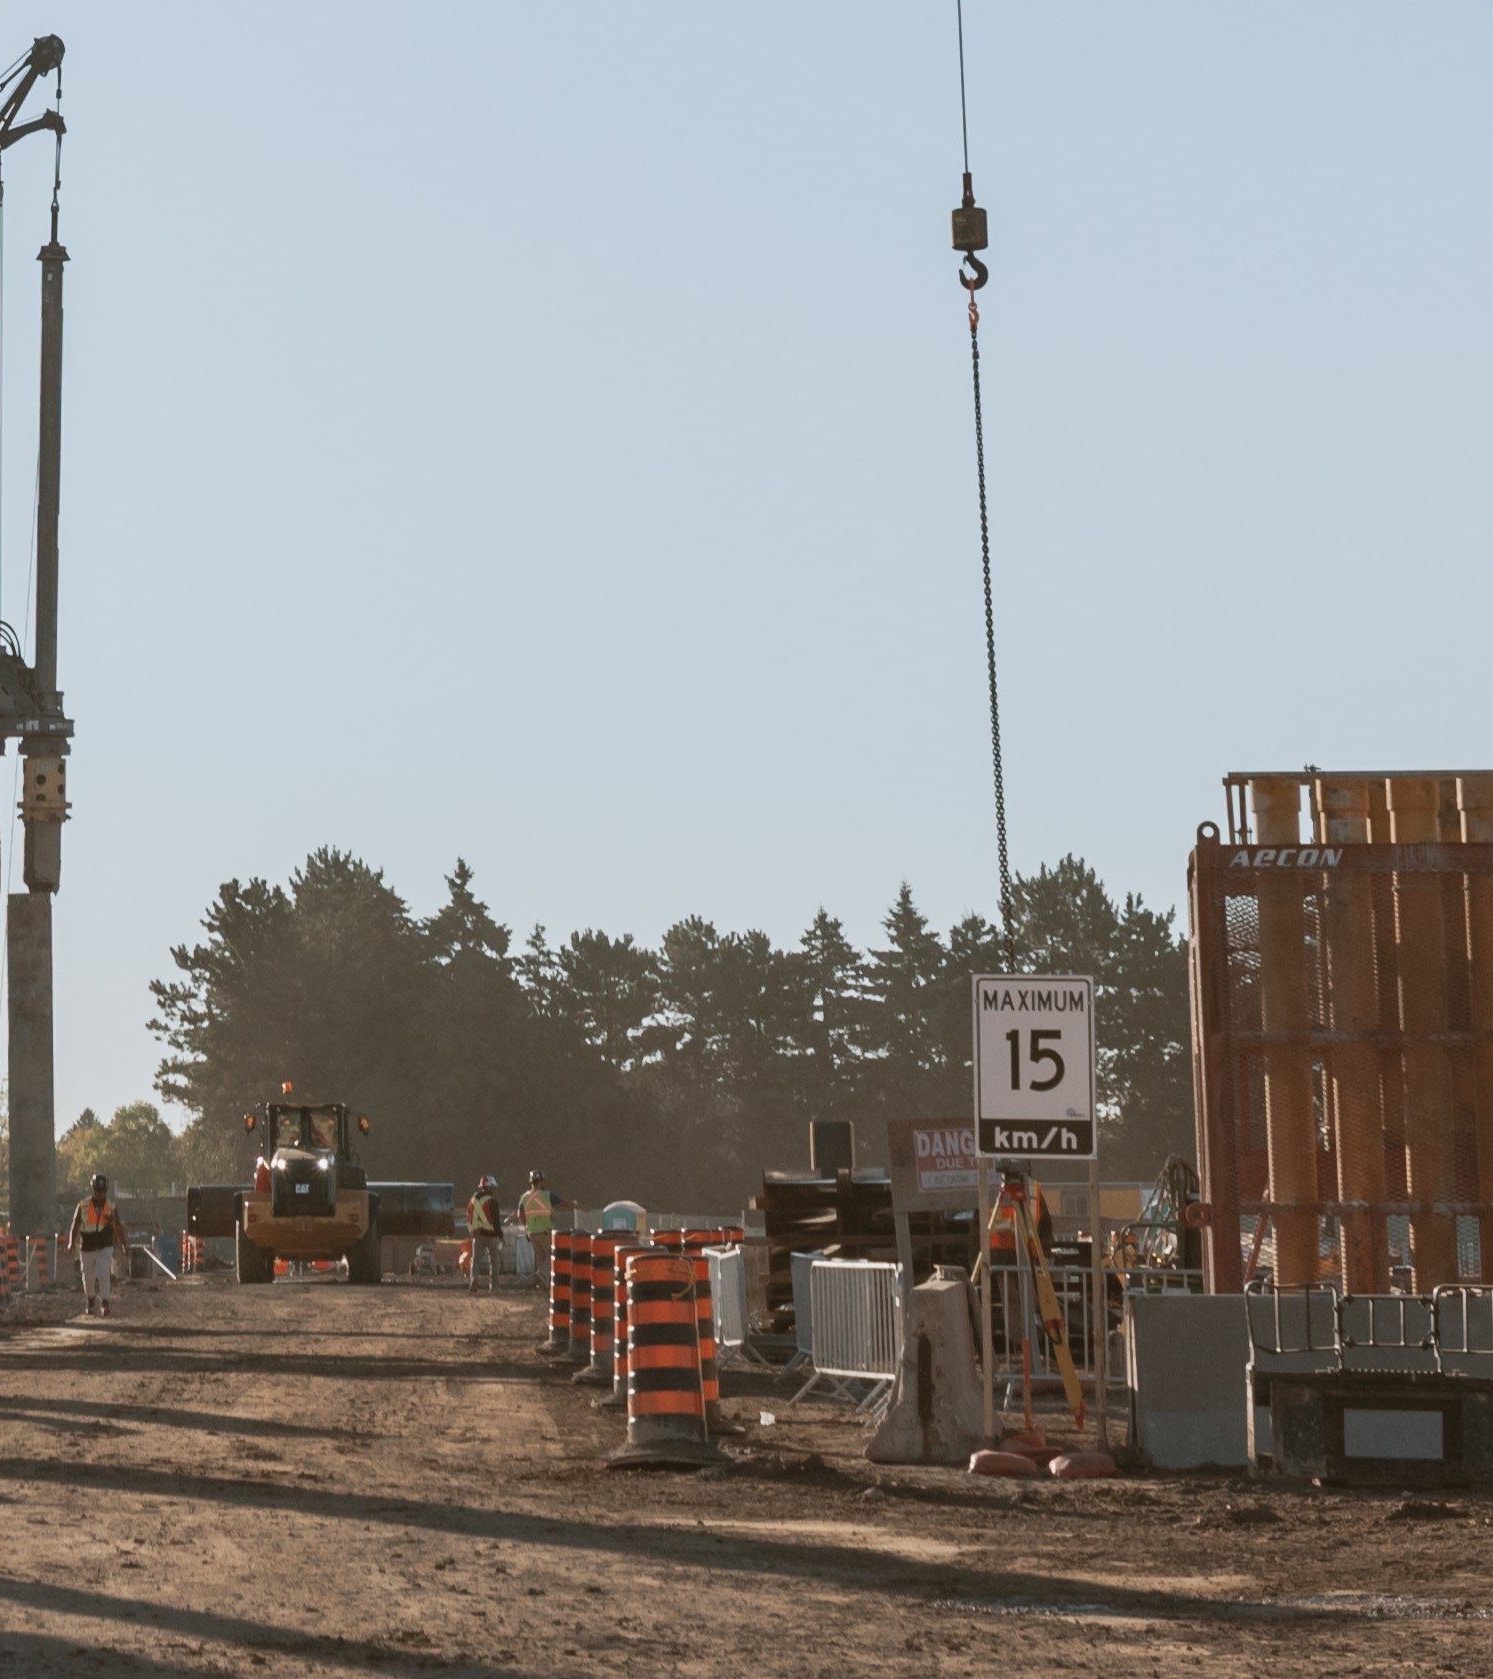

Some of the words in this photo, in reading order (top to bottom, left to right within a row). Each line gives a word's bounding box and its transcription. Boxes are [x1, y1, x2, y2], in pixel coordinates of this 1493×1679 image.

[983, 989, 1084, 1012] MAXIMUM
[1005, 1028, 1065, 1092] 15
[917, 1130, 975, 1157] DANG
[994, 1126, 1078, 1150] km/h
[936, 1157, 964, 1169] DUE
[295, 1183, 310, 1194] CAT
